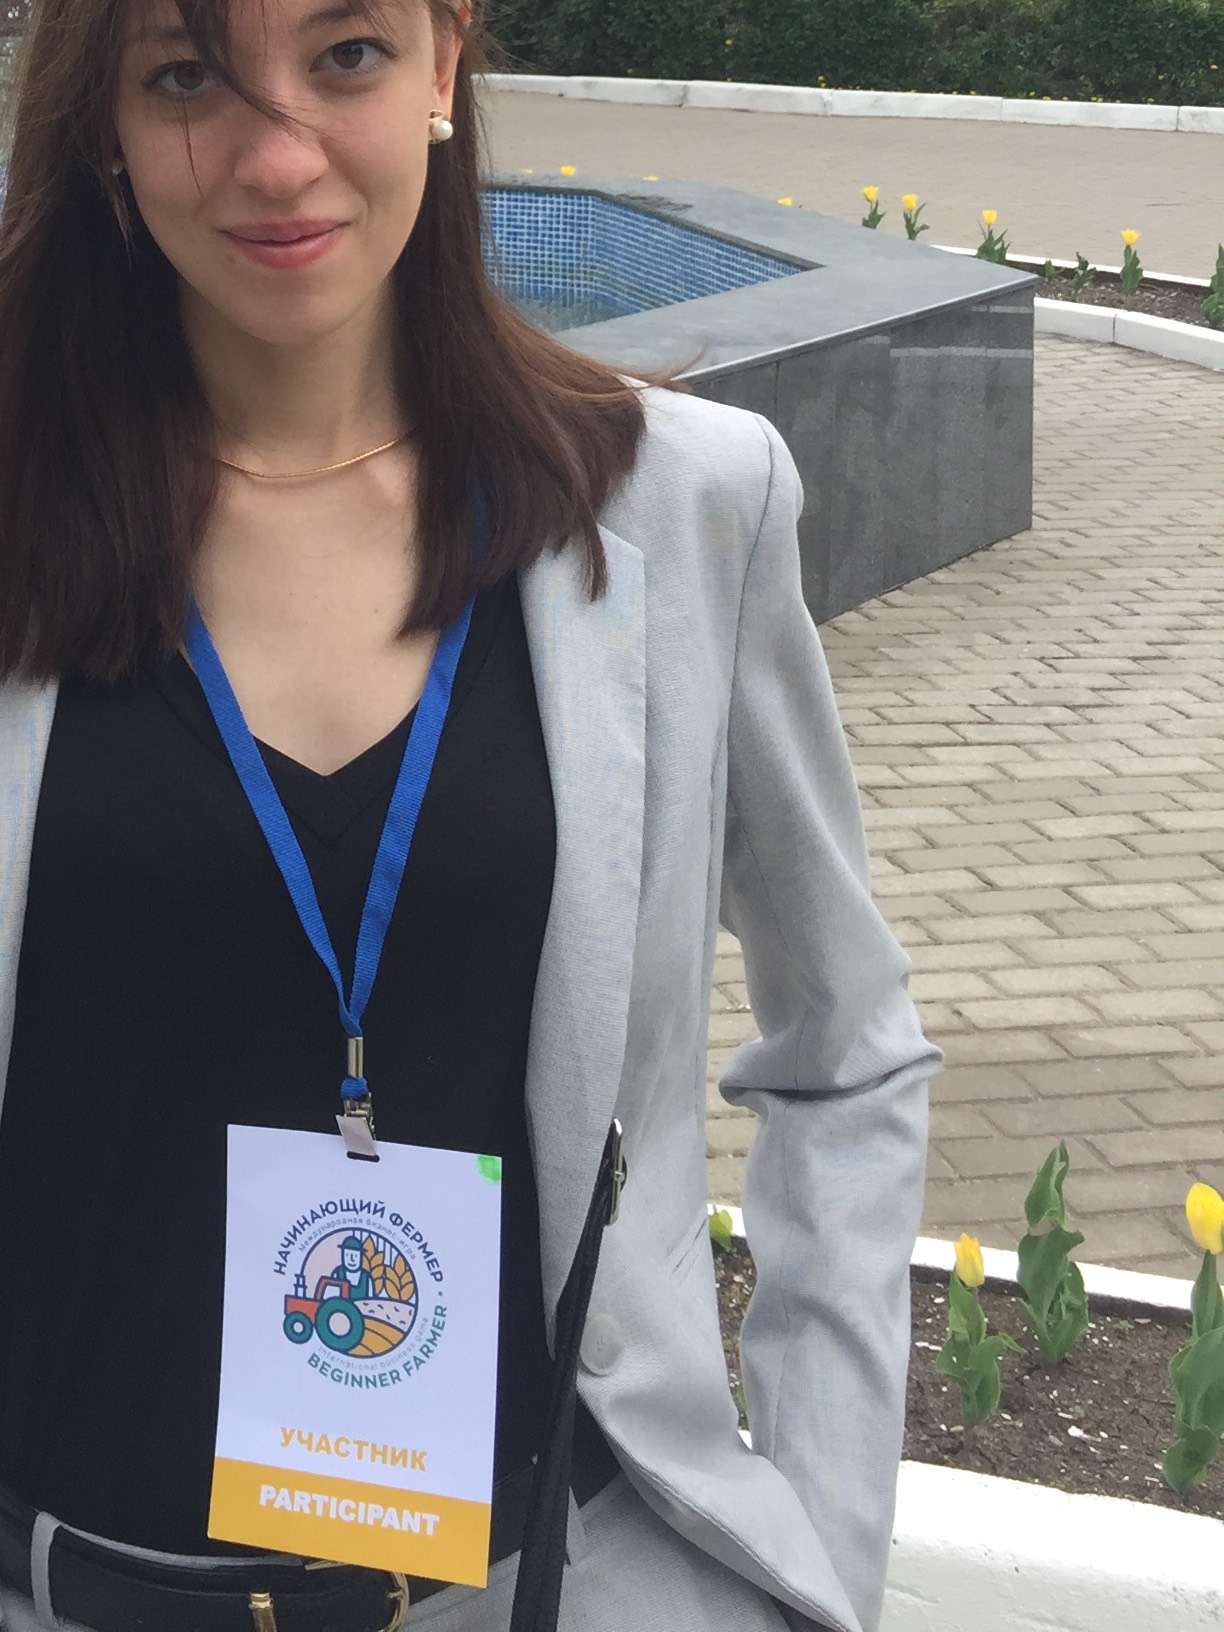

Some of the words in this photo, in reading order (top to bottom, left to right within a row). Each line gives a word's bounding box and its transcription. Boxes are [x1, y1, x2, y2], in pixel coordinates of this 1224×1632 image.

[273, 1198, 386, 1275] НАЧИНАЮЩИЙ
[389, 1212, 444, 1283] ФЕРМЕР
[307, 1352, 402, 1389] BEGINNER
[402, 1304, 448, 1376] FARMER
[279, 1426, 428, 1472] УЧАСТНИК
[259, 1484, 440, 1536] PARTICIPANT
